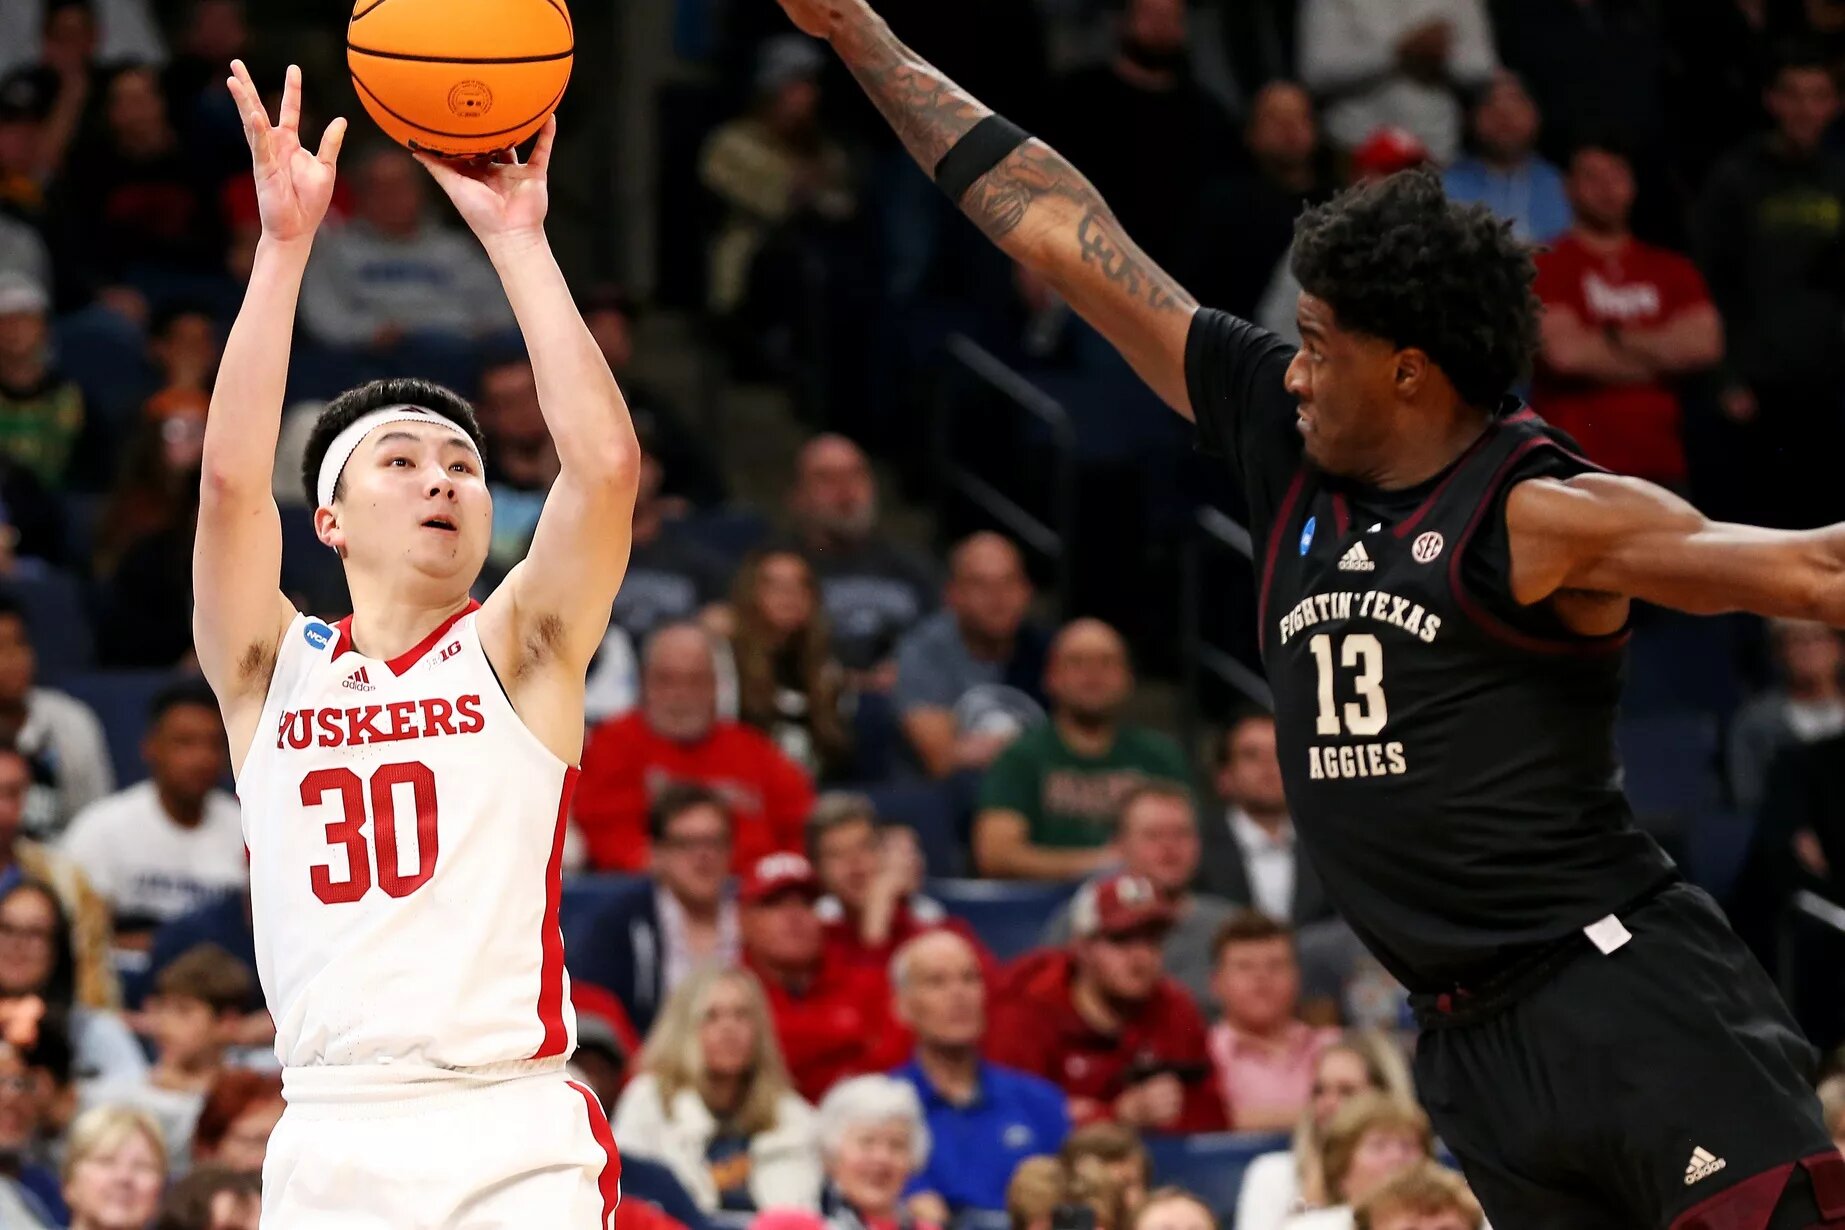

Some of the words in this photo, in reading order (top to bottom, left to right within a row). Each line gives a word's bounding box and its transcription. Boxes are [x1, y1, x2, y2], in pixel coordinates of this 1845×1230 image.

[1337, 559, 1376, 572] adidas
[1359, 590, 1441, 642] TEXAS
[306, 629, 329, 646] NCA
[342, 680, 376, 692] adidas
[1308, 633, 1387, 736] 13
[1308, 741, 1407, 780] AGGIES
[299, 760, 439, 904] 30
[1684, 1157, 1726, 1186] adidas
